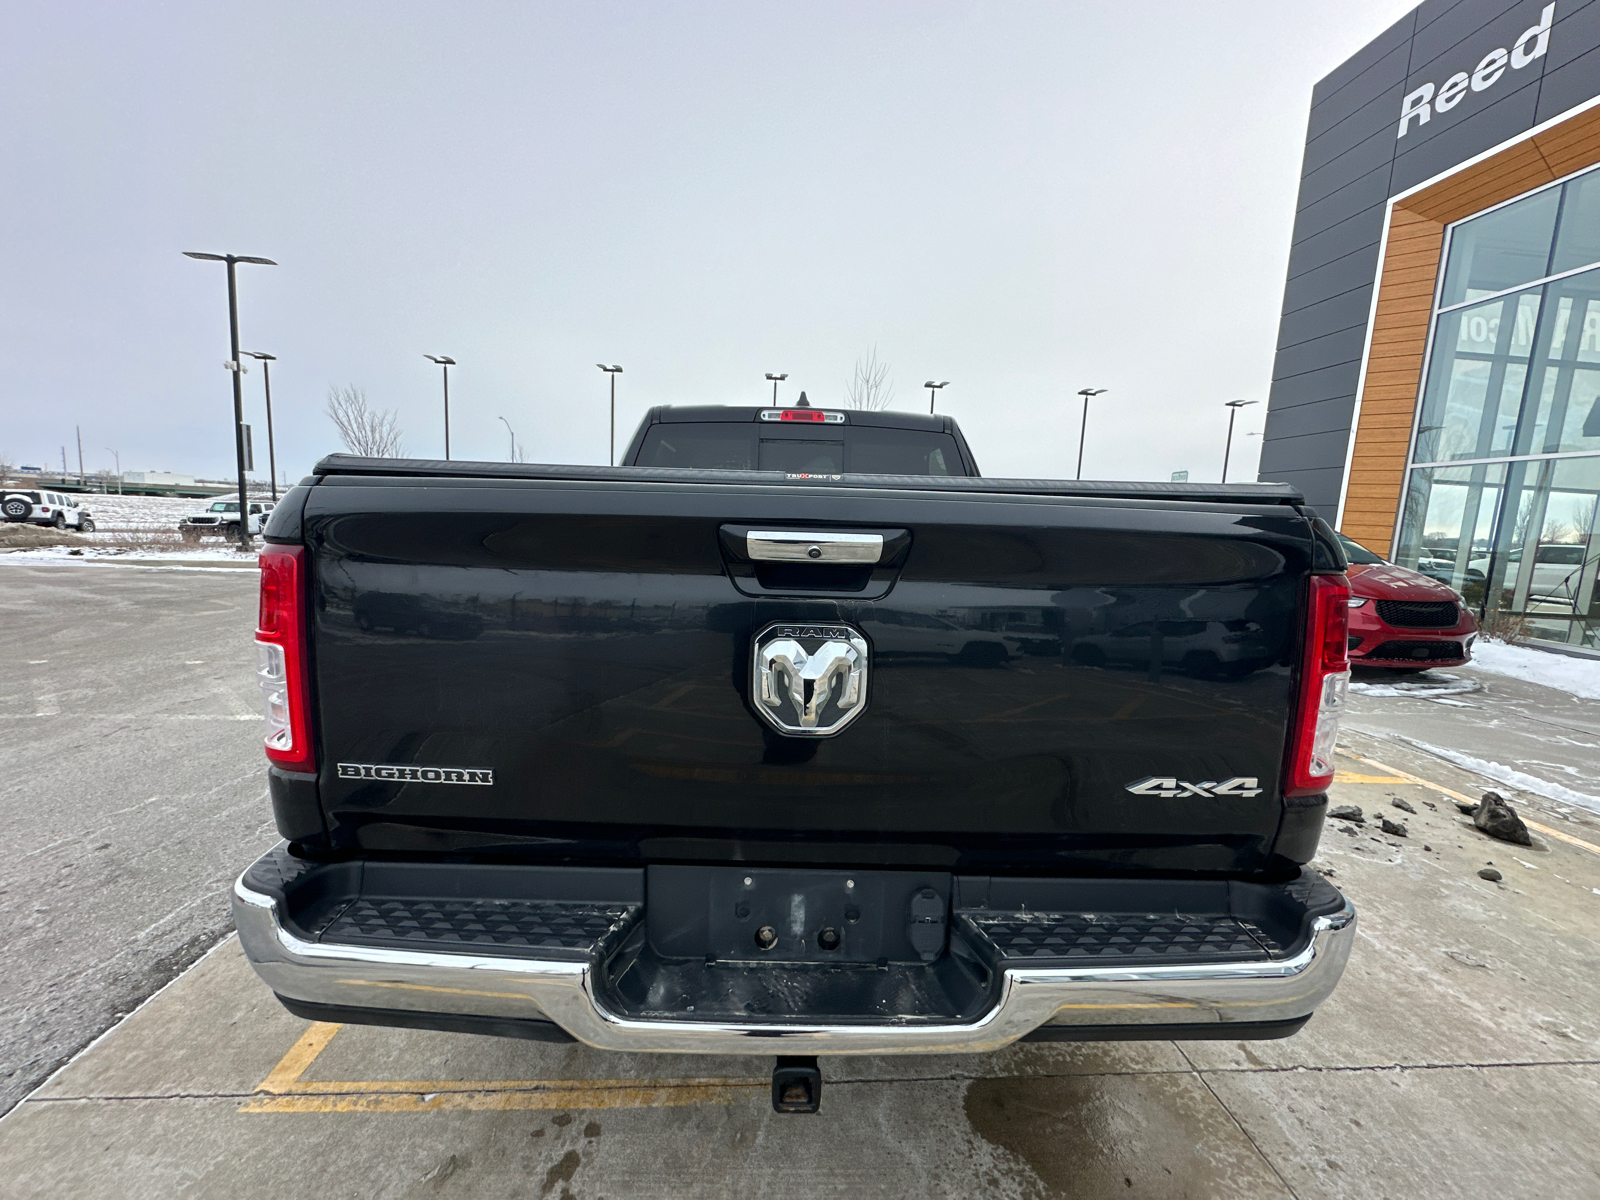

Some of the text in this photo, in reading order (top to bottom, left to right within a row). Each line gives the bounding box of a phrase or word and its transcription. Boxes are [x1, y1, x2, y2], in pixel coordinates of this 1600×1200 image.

[1397, 2, 1556, 139] Reed
[777, 627, 846, 638] RAM
[337, 763, 494, 785] BIGHORN
[1125, 776, 1263, 797] 4x4
